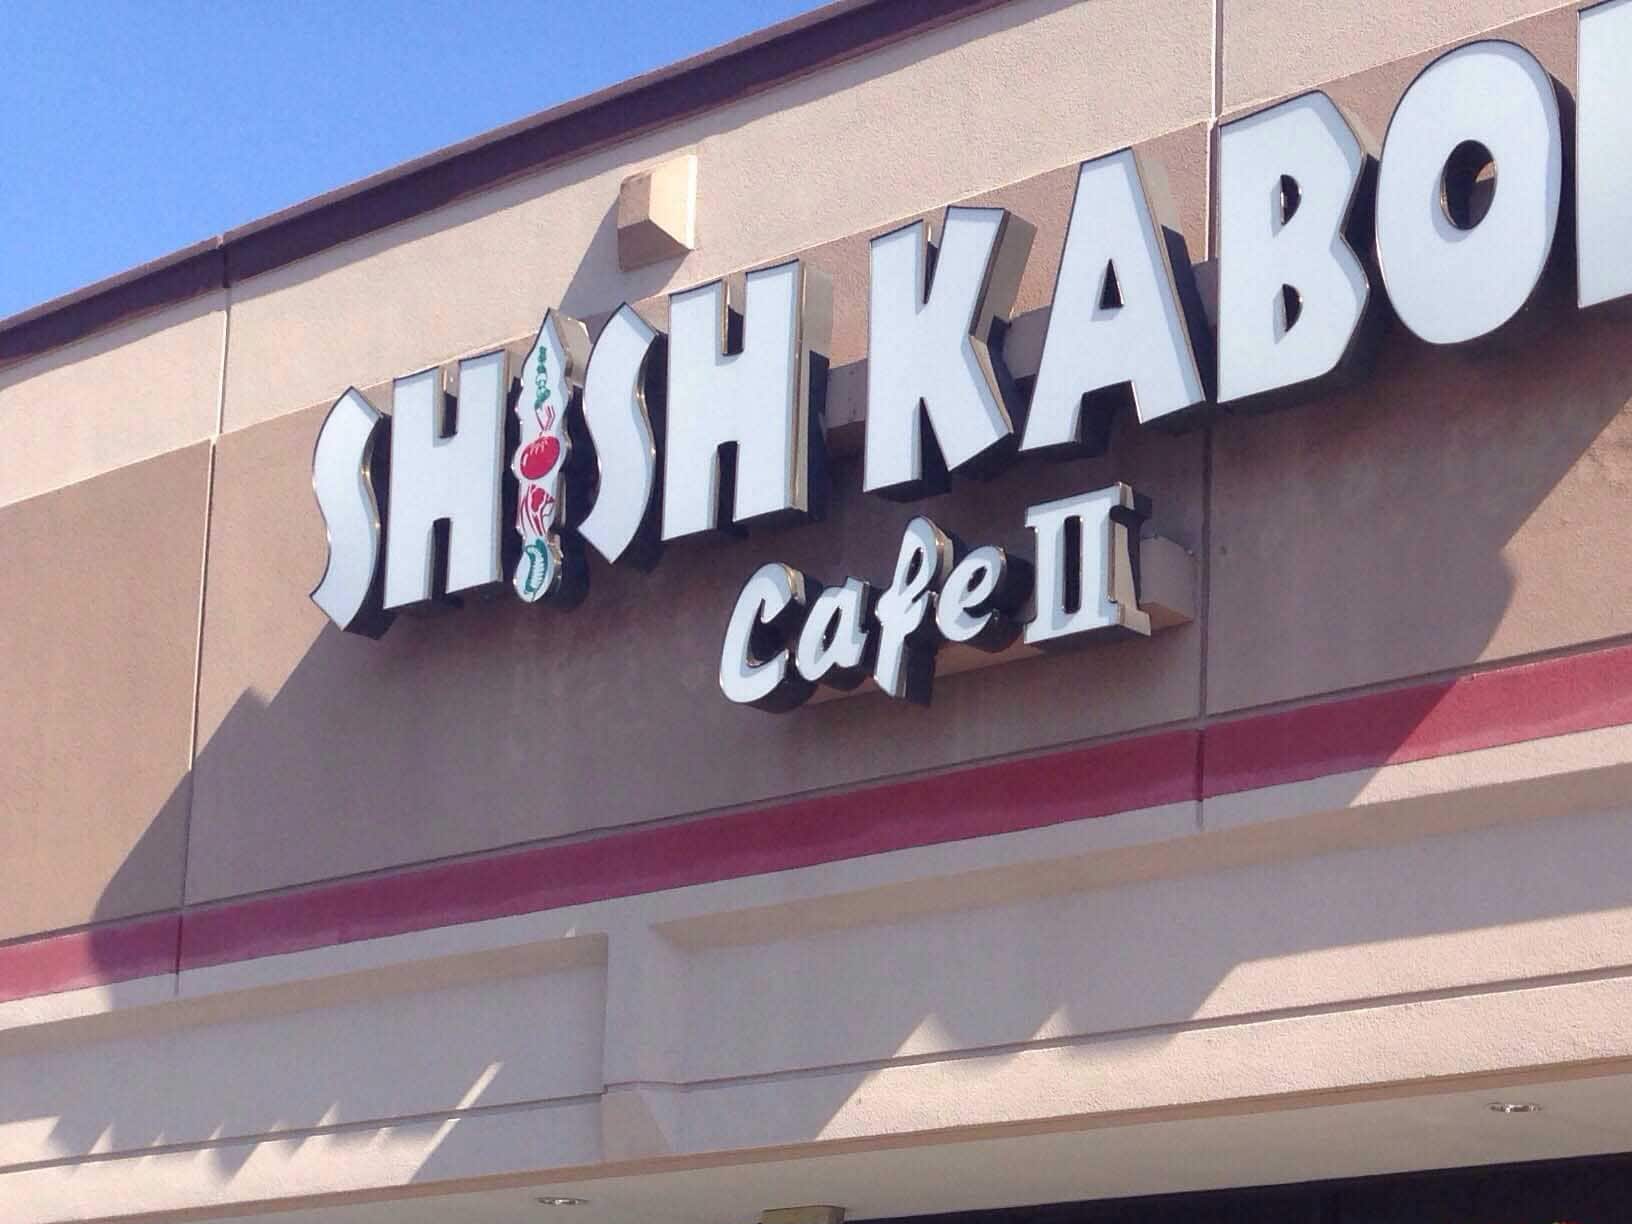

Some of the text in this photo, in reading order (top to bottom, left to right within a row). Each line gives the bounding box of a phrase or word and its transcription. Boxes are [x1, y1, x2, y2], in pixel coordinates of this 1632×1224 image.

[309, 258, 800, 632] SHISH
[719, 481, 1142, 704] Cafe II
